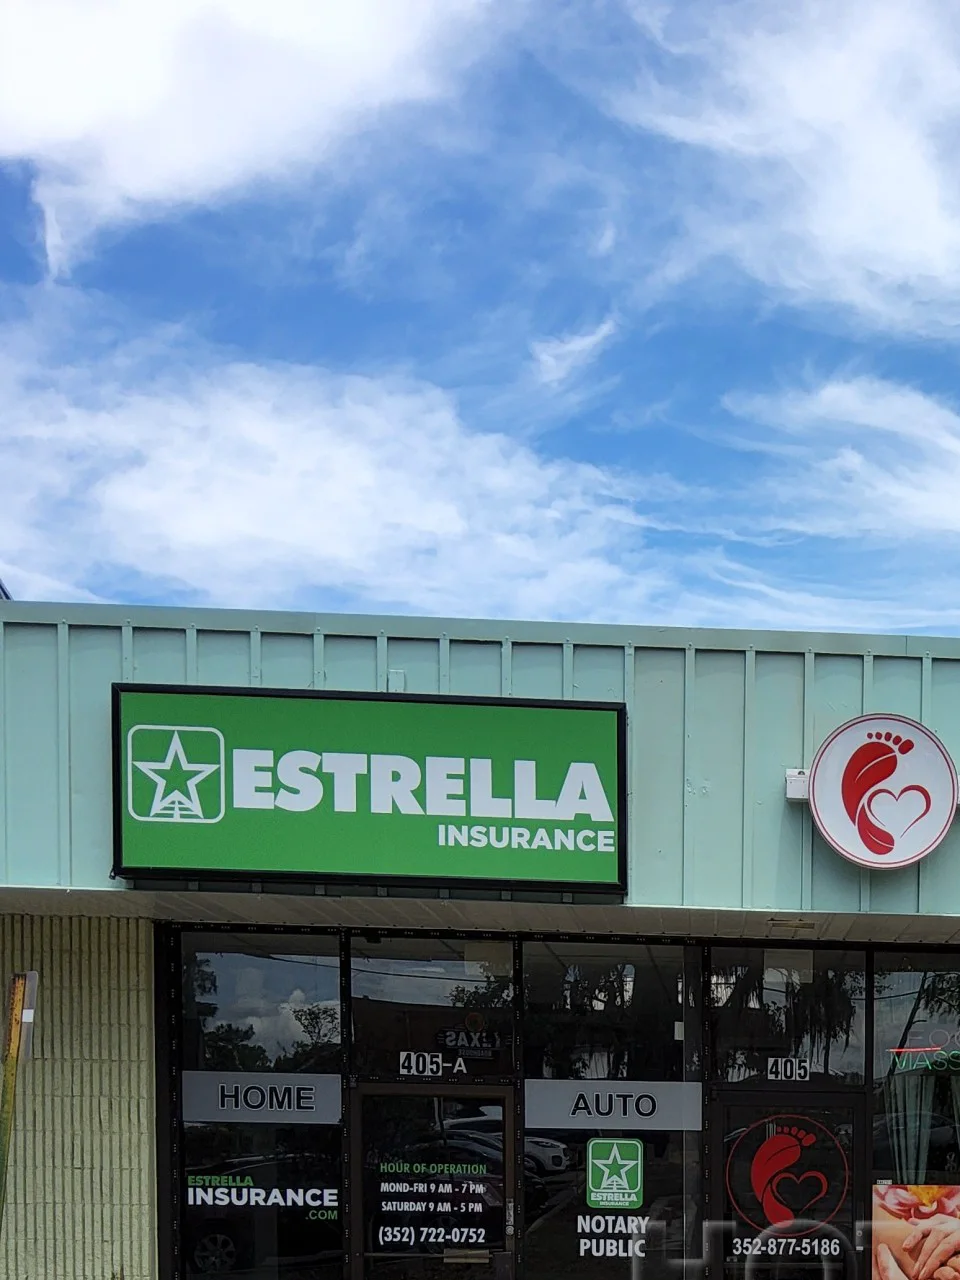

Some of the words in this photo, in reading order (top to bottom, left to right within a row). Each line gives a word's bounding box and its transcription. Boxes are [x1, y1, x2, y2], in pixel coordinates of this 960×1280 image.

[232, 748, 615, 822] ESTRELLA
[438, 823, 616, 853] INSURANCE
[400, 1052, 467, 1077] 405-A
[767, 1057, 810, 1081] 405
[218, 1083, 316, 1112] HOME
[569, 1091, 658, 1118] AUTO
[380, 1162, 411, 1174] HOUR
[413, 1163, 426, 1174] OF
[429, 1163, 487, 1175] OPERATION
[188, 1175, 254, 1187] ESTRELLA
[380, 1182, 427, 1194] MOND-FRI
[430, 1183, 436, 1193] 9
[437, 1183, 453, 1194] AM
[461, 1183, 467, 1194] 7
[469, 1183, 484, 1195] PM
[188, 1187, 339, 1207] INSURANCE
[381, 1201, 427, 1212] SATURDAY
[428, 1202, 435, 1212] 9
[436, 1202, 452, 1213] AM
[460, 1202, 466, 1213] 5
[468, 1202, 483, 1213] PM
[590, 1192, 638, 1202] ESTRELLA
[305, 1210, 338, 1221] .COM
[577, 1214, 650, 1234] NOTARY
[378, 1226, 415, 1246] (352)
[419, 1227, 486, 1244] 722-0752
[579, 1238, 646, 1258] PUBLIC
[732, 1237, 841, 1256] 352-877-5186
